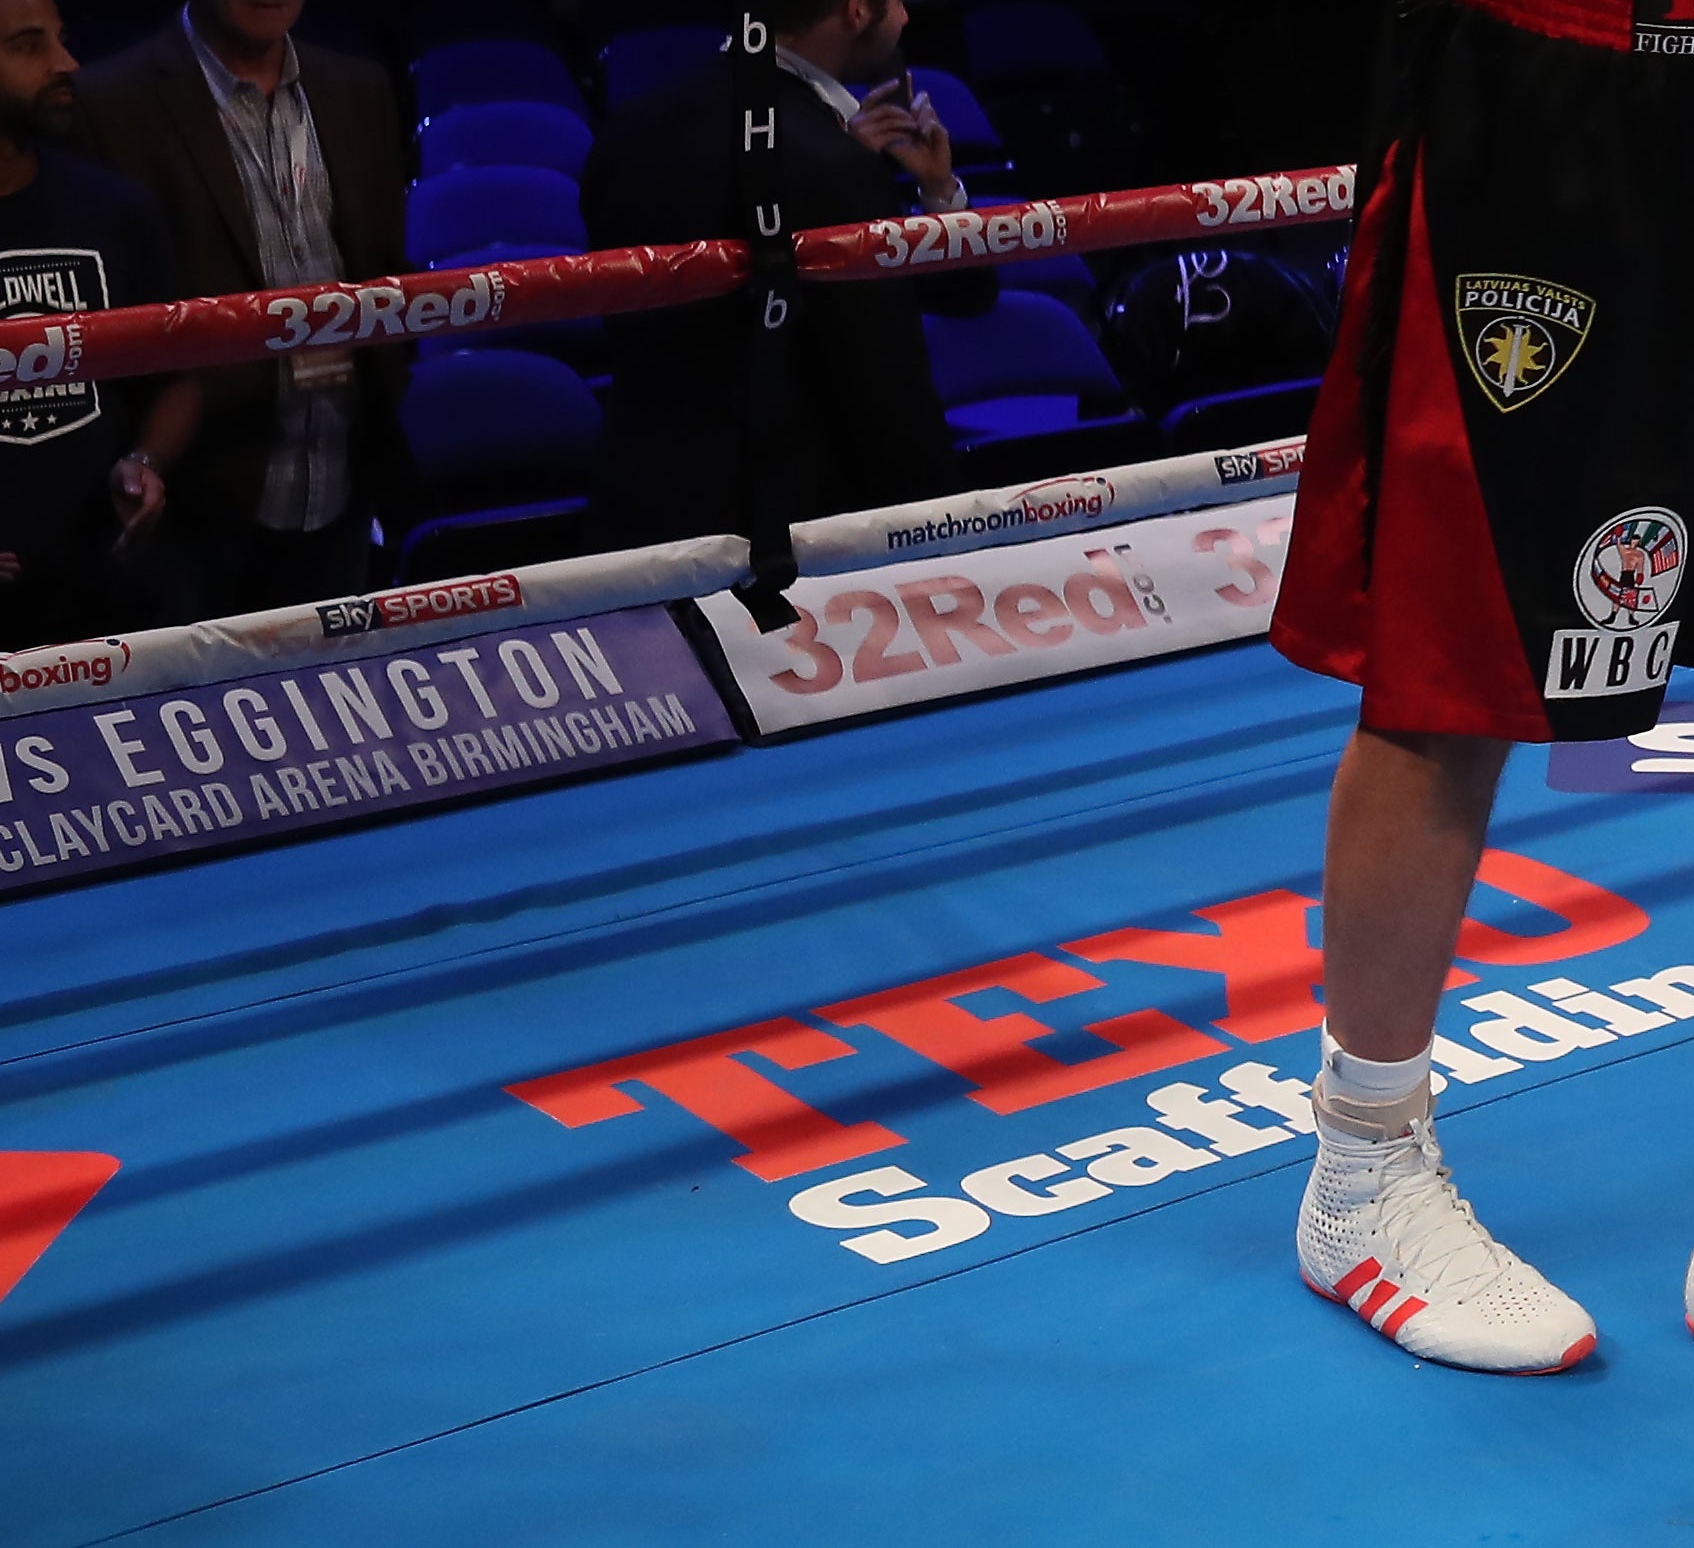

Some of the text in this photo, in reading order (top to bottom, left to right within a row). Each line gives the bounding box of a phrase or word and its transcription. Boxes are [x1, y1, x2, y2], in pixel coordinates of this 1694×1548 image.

[1464, 290, 1581, 329] POLICIJA
[384, 579, 516, 621] SPORTS
[1559, 629, 1671, 691] WBC
[93, 626, 625, 788] EGGINGTON
[254, 749, 411, 822] ARENA
[408, 693, 698, 788] BIRMINGHAM
